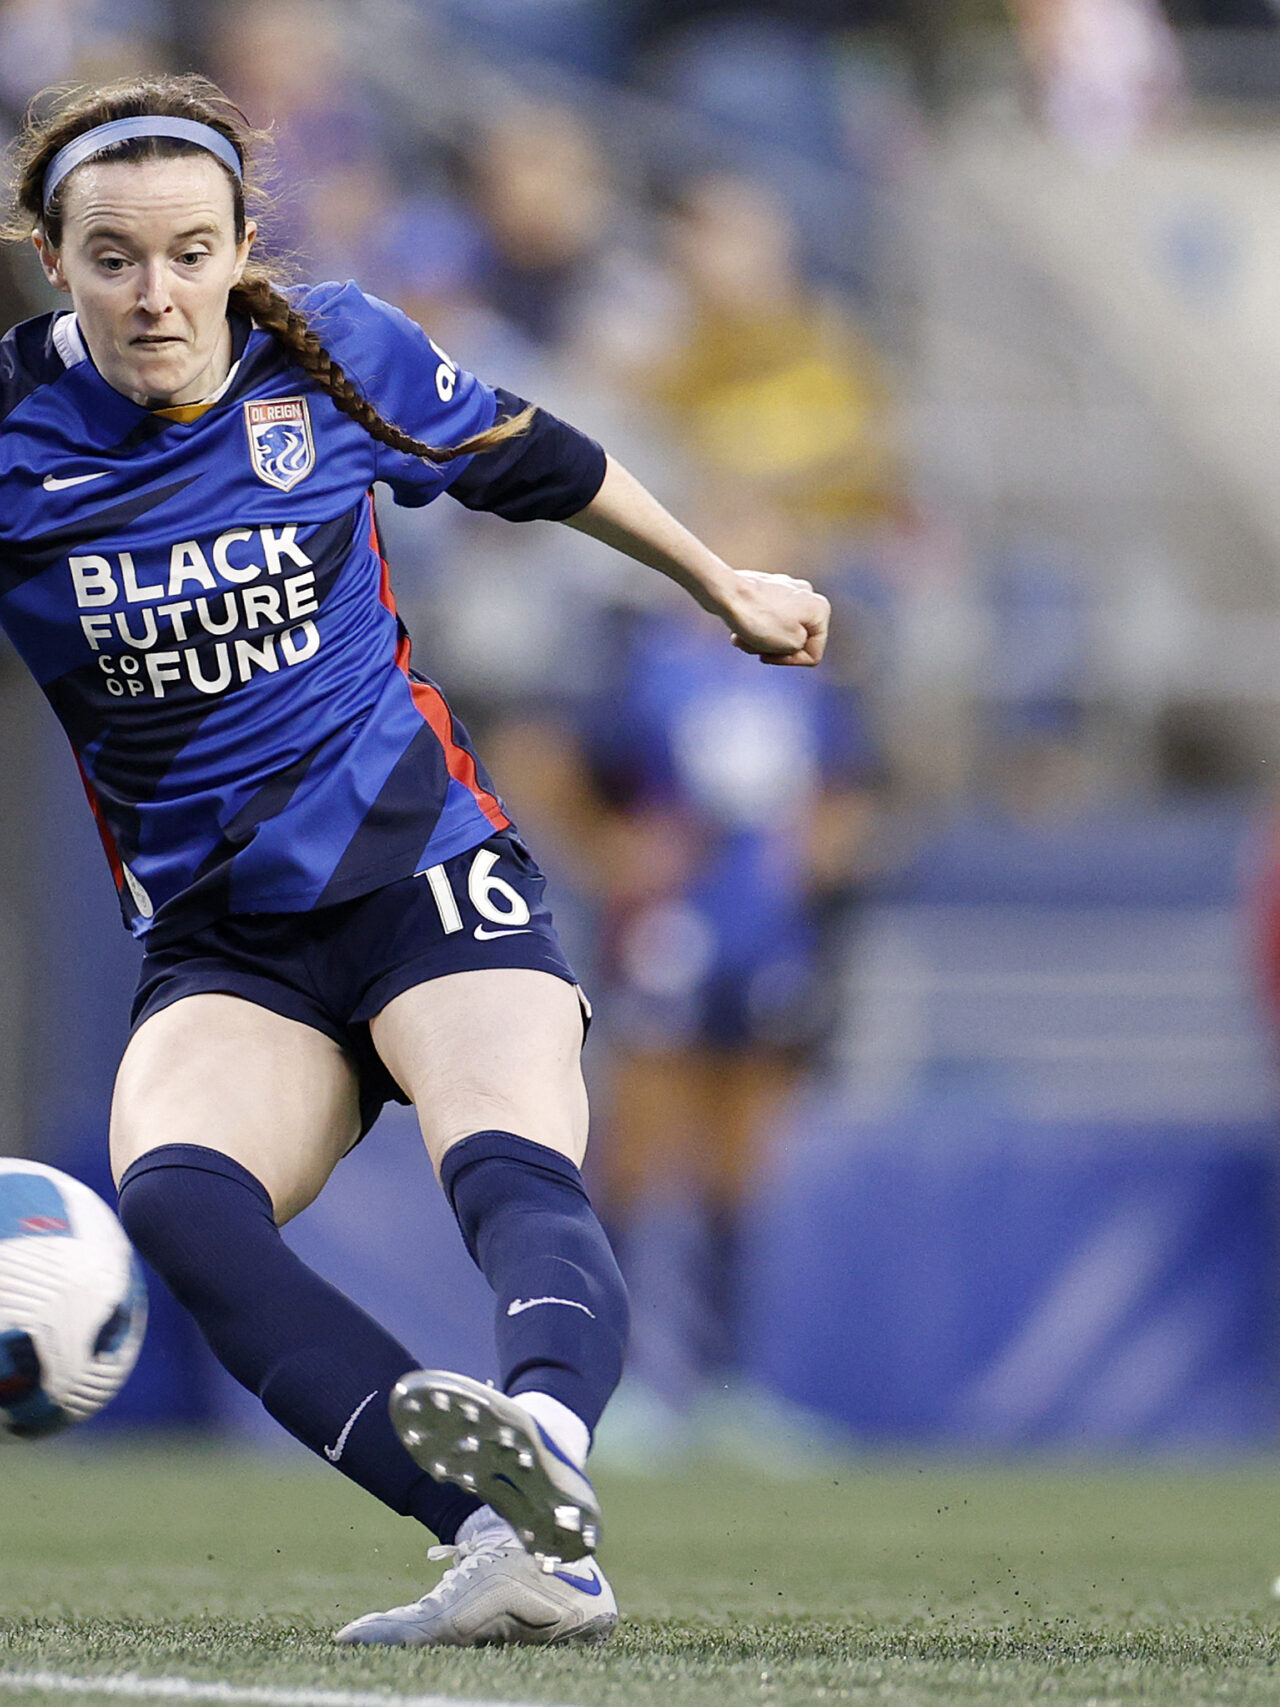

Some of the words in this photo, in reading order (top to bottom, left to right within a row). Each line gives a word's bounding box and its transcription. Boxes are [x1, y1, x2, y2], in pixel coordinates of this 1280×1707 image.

[252, 408, 267, 423] OL
[267, 404, 302, 420] REIGN
[68, 523, 314, 608] BLACK
[79, 570, 319, 650] FUTURE
[98, 655, 140, 675] CO
[106, 678, 144, 697] OP
[144, 619, 321, 698] FUND
[413, 848, 531, 935] 16
